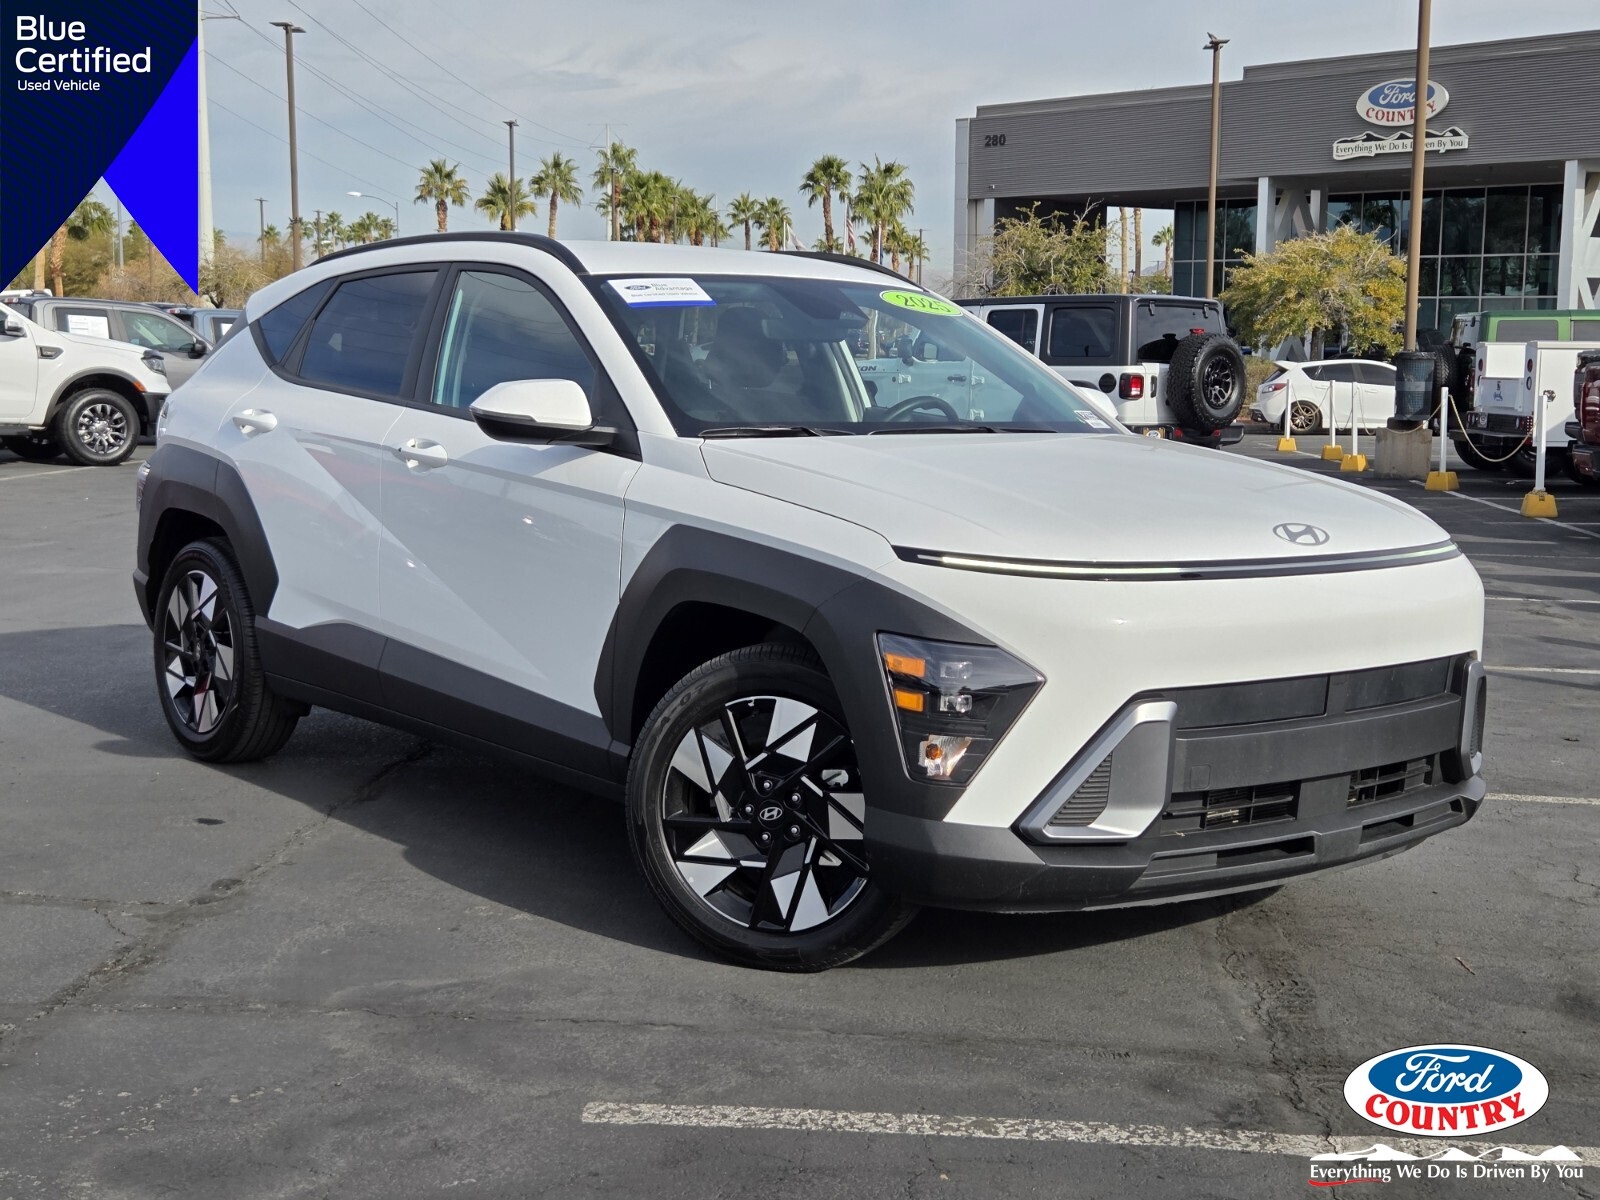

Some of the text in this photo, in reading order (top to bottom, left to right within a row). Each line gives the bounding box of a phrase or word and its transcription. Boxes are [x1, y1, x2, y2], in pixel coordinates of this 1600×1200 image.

[1365, 100, 1437, 123] COUNTY
[984, 134, 1006, 147] 280
[1335, 143, 1373, 154] Everything
[1375, 143, 1387, 151] We
[1389, 142, 1400, 151] Do
[1401, 141, 1408, 149] Is
[1437, 140, 1447, 149] By
[1449, 140, 1464, 148] You
[895, 294, 951, 313] 2025
